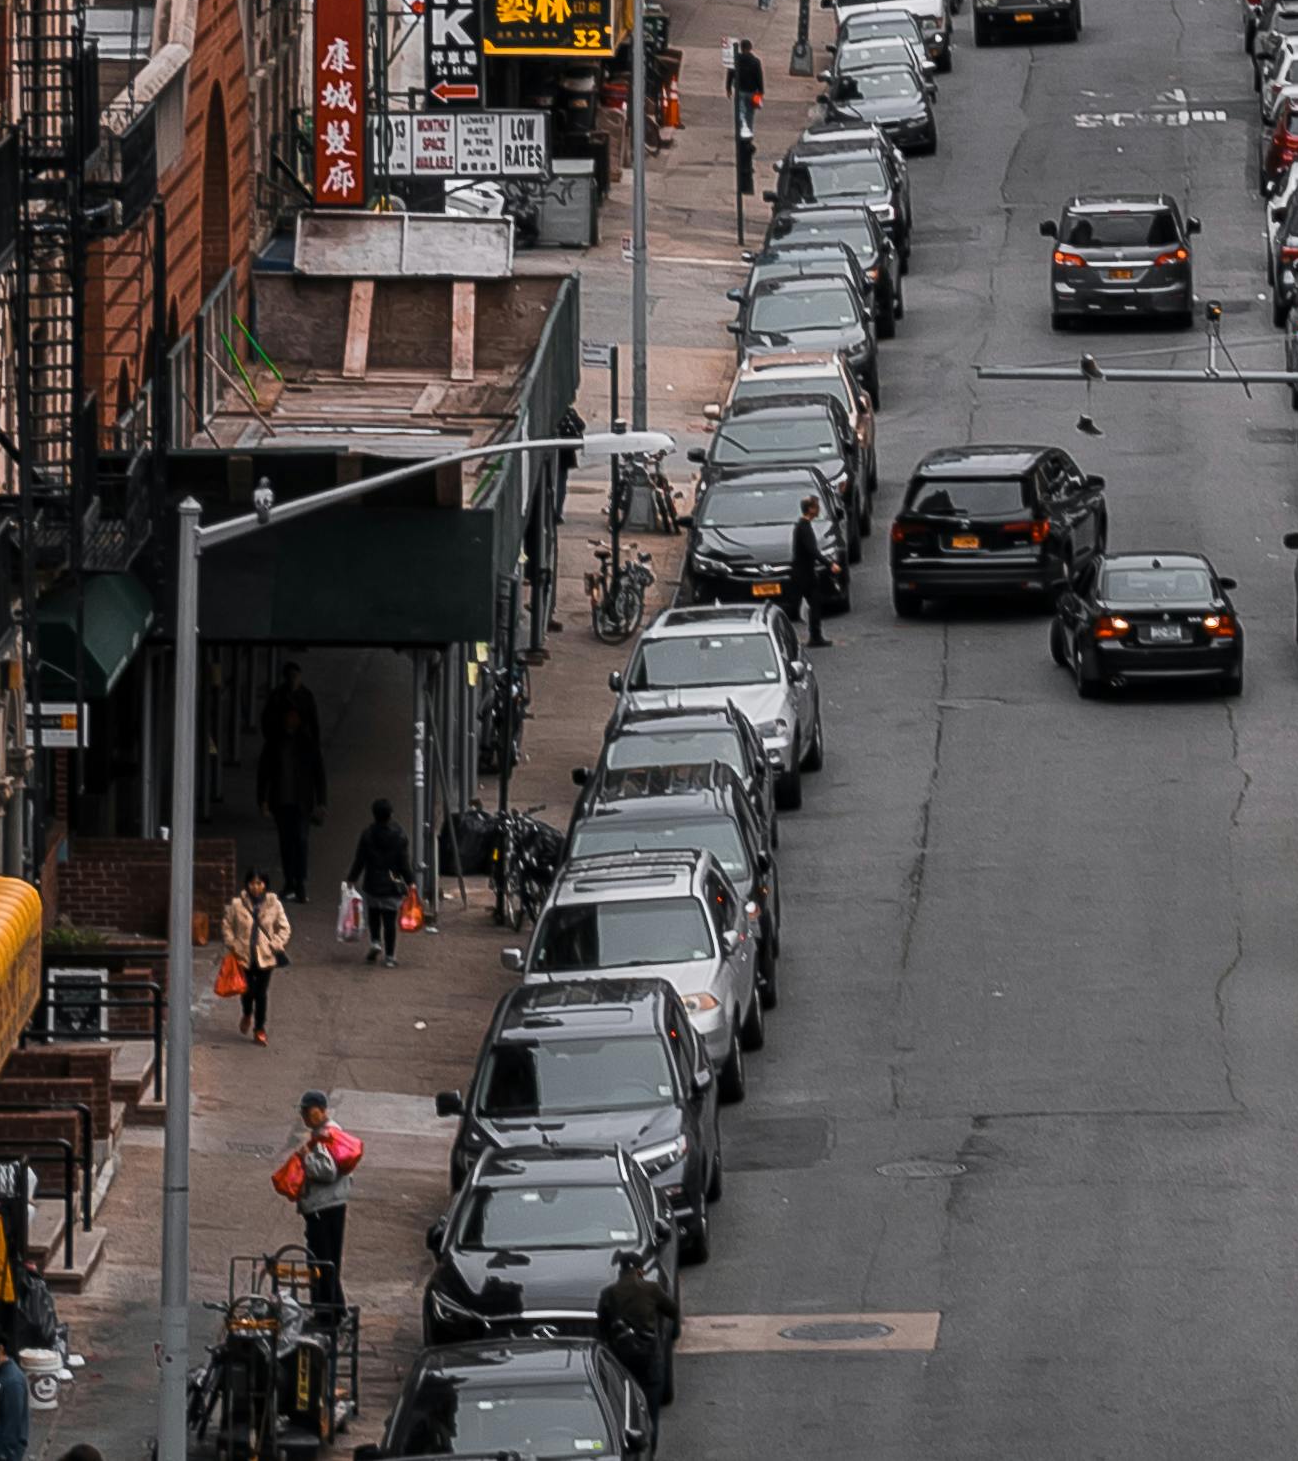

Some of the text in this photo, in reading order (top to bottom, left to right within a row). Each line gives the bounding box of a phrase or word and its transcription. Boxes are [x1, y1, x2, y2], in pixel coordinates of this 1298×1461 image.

[573, 29, 601, 48] 32
[510, 117, 535, 141] LOW
[422, 137, 446, 151] SPACE
[504, 144, 543, 167] RATES
